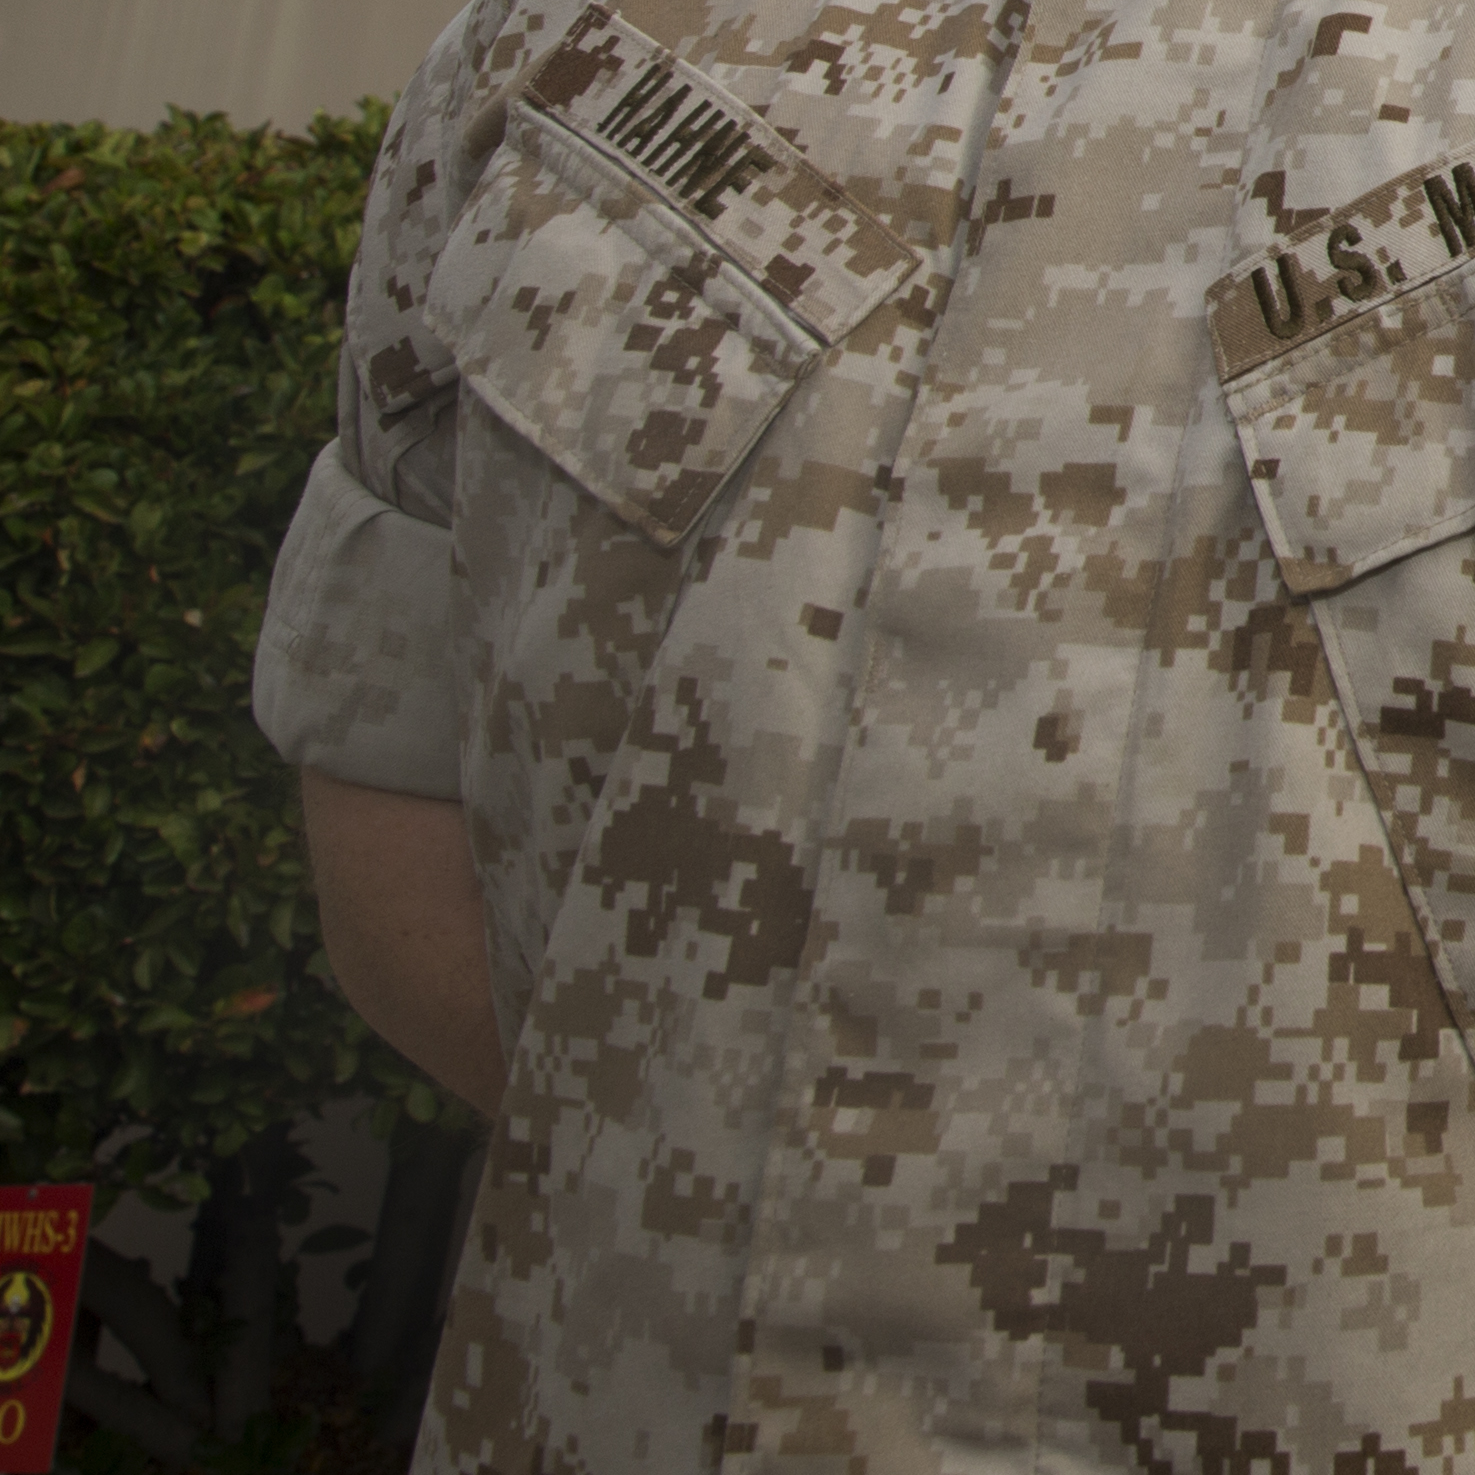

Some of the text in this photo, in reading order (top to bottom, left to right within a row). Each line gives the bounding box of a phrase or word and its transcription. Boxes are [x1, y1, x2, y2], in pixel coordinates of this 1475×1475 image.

[597, 63, 777, 221] HAHNE
[1251, 224, 1407, 341] U.S.
[0, 1210, 80, 1254] WHS-3
